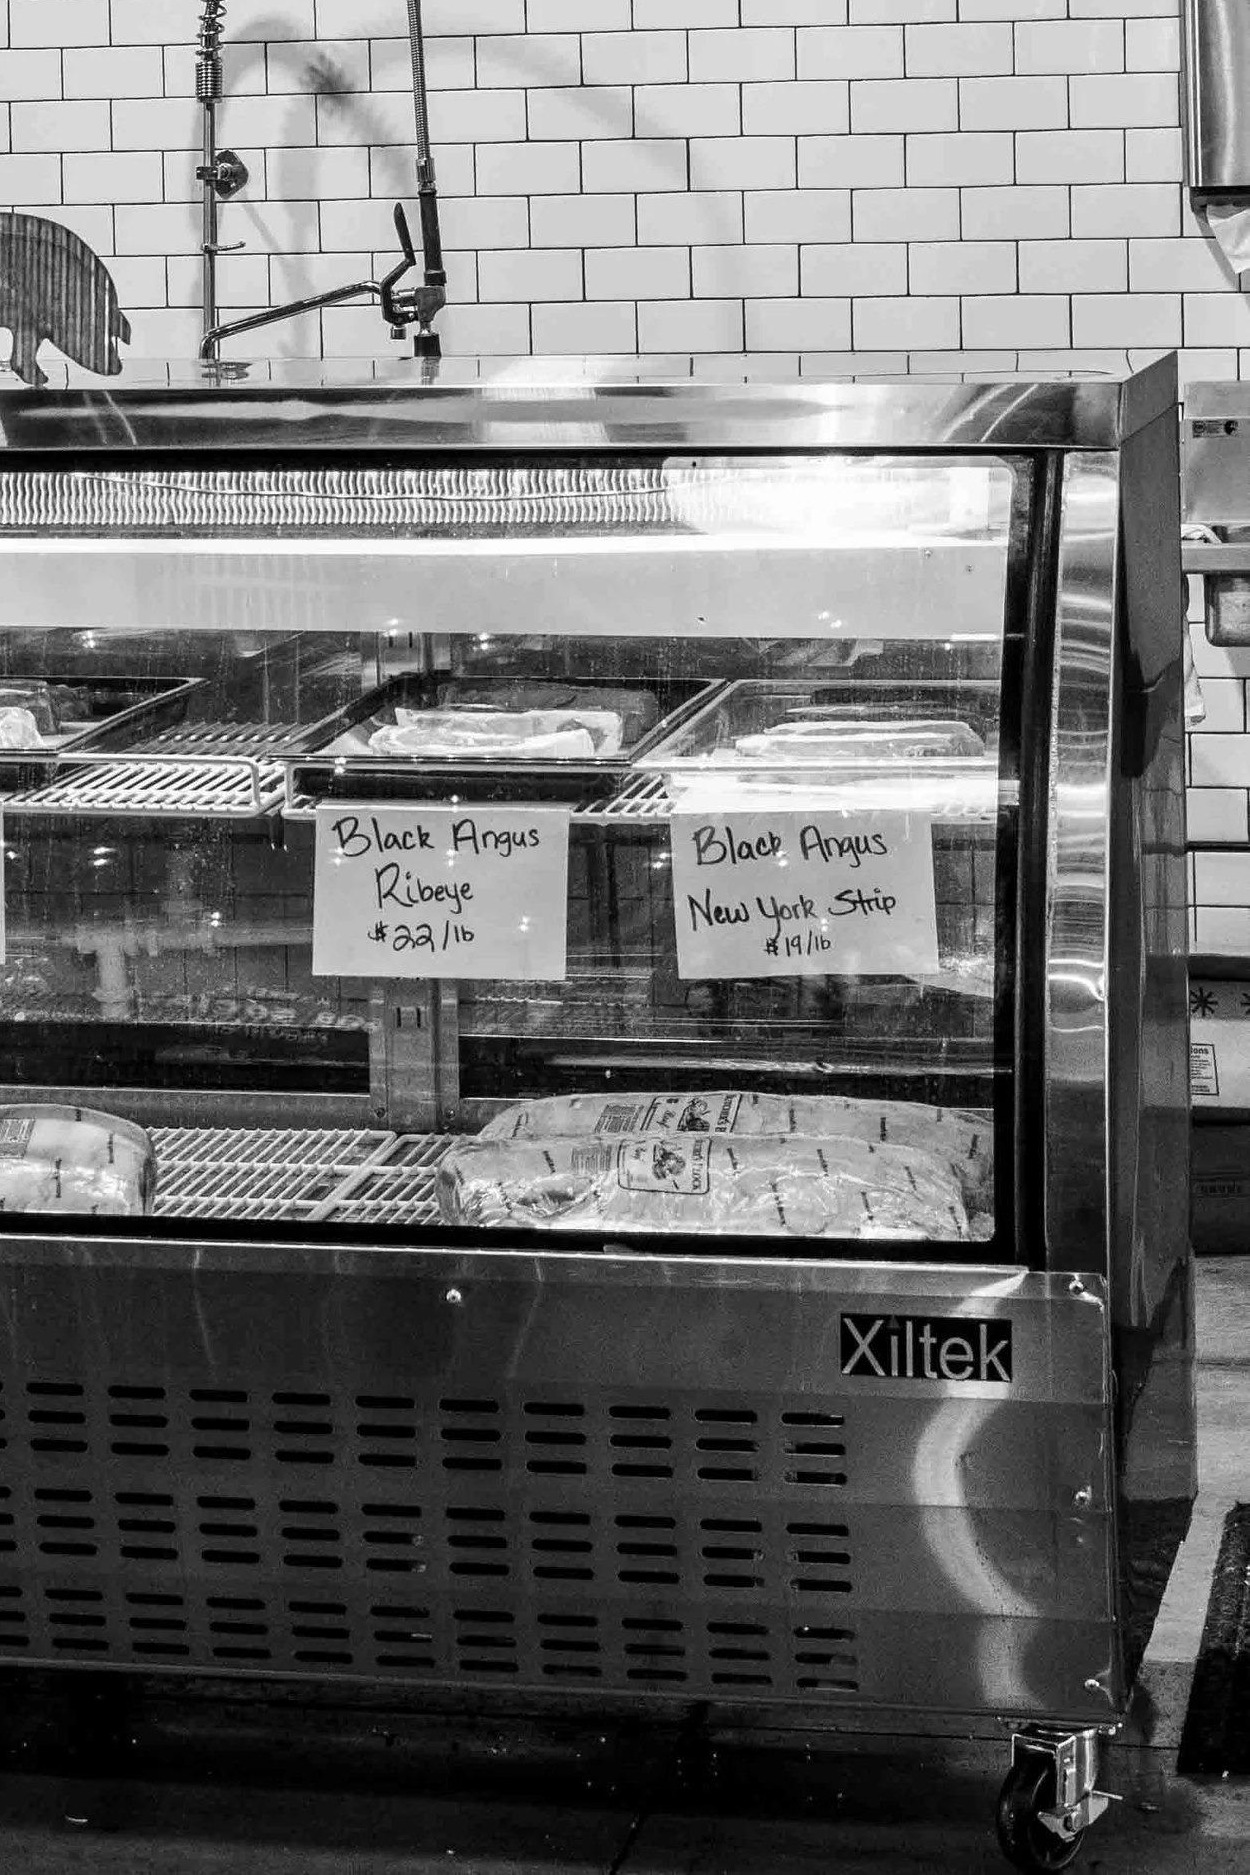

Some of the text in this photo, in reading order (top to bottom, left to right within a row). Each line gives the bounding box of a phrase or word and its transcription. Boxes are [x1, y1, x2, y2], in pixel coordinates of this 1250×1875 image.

[331, 816, 540, 857] Black Angus
[692, 825, 888, 867] Black Angus
[374, 863, 474, 915] Ribeye
[368, 920, 474, 952] $22/lb
[687, 888, 896, 941] New York Strip
[842, 1317, 1011, 1382] Xiltek
